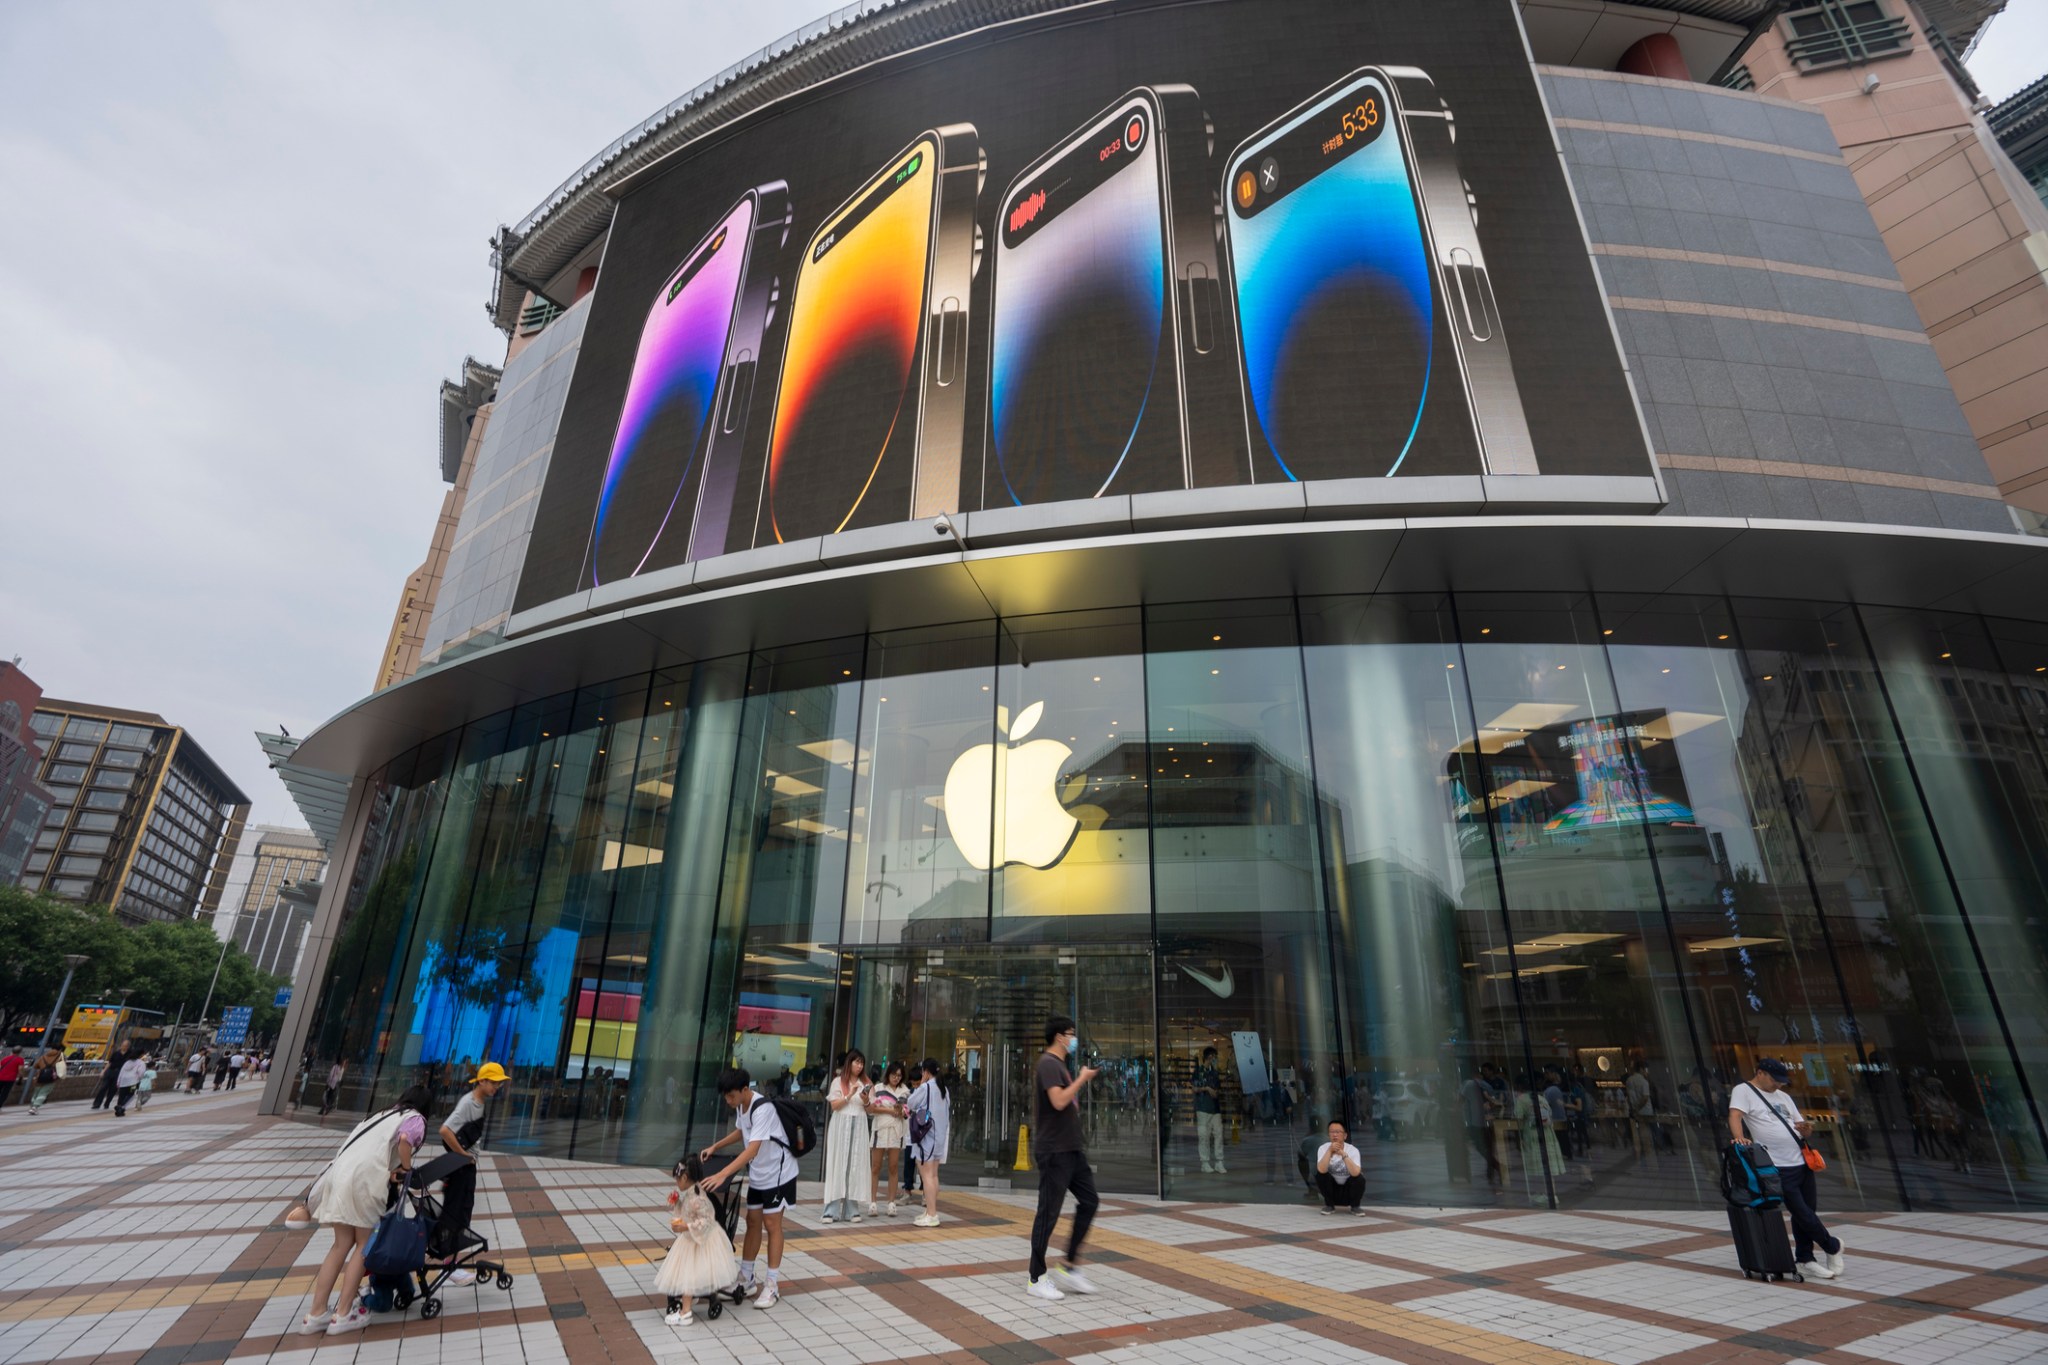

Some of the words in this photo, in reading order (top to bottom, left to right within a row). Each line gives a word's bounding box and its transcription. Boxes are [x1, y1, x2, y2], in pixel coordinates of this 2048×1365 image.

[1322, 134, 1344, 155] 计时器
[1342, 98, 1379, 141] 5:33
[1100, 138, 1121, 161] 00:33
